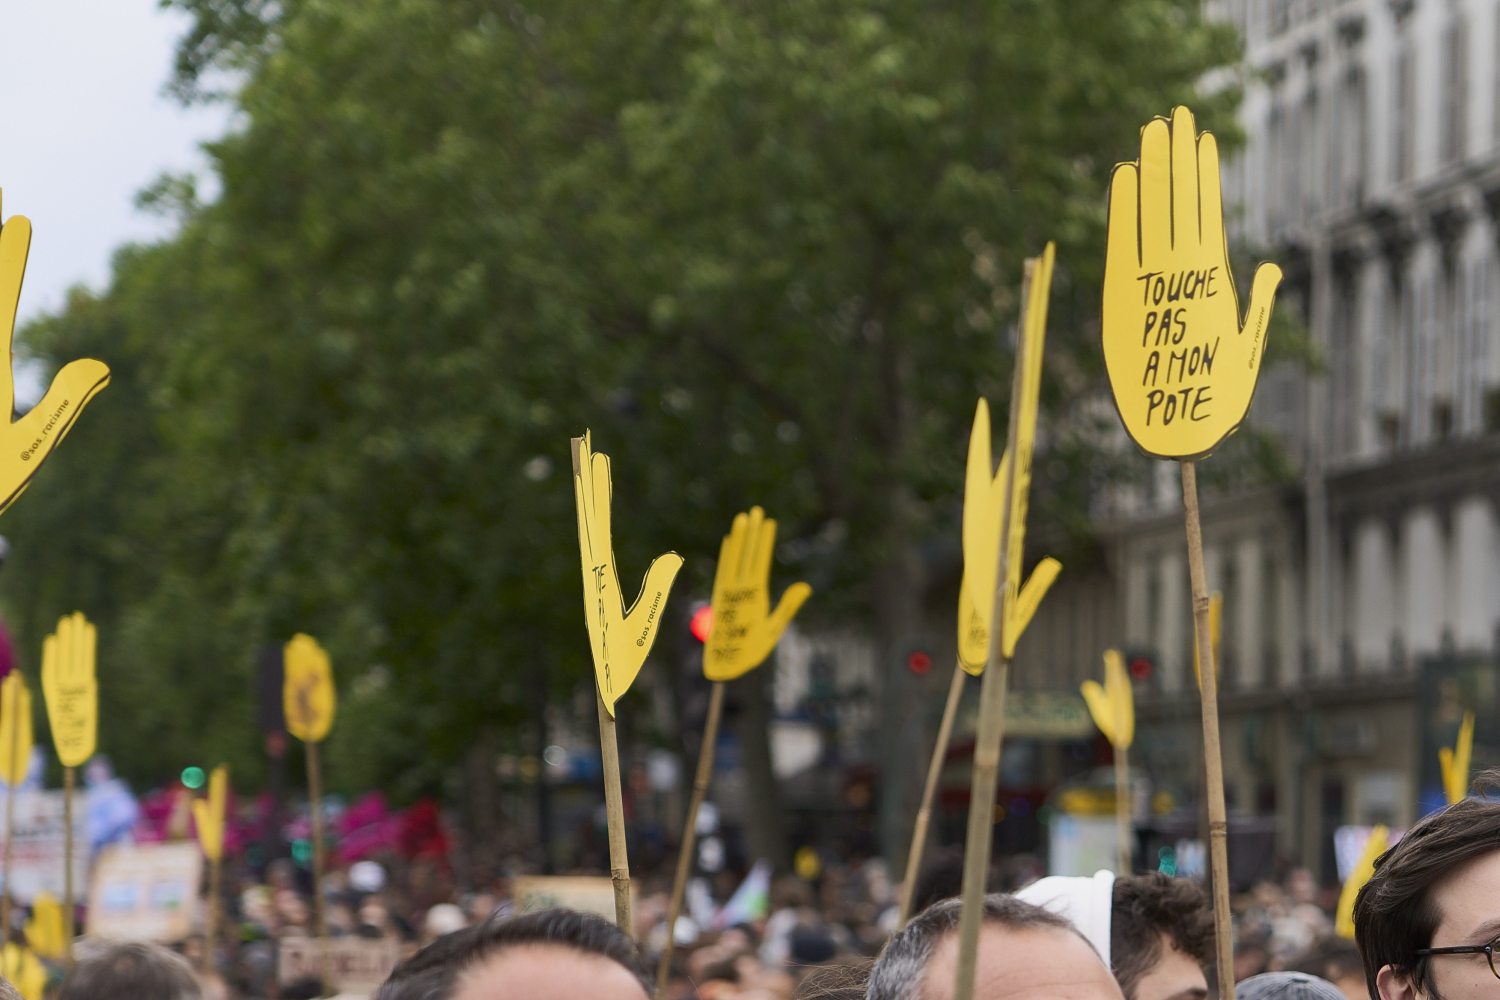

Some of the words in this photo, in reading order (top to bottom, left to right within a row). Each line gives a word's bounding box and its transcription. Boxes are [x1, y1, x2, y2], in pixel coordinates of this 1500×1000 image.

[1137, 266, 1219, 306] TOUCHE
[1143, 308, 1187, 347] PAS
[1248, 306, 1266, 370] @sos_racisme
[1143, 350, 1161, 387] A
[1166, 336, 1220, 385] MON
[20, 399, 70, 462] @sos_racisme
[1146, 386, 1213, 426] POTE
[636, 591, 663, 648] @sos_racisme
